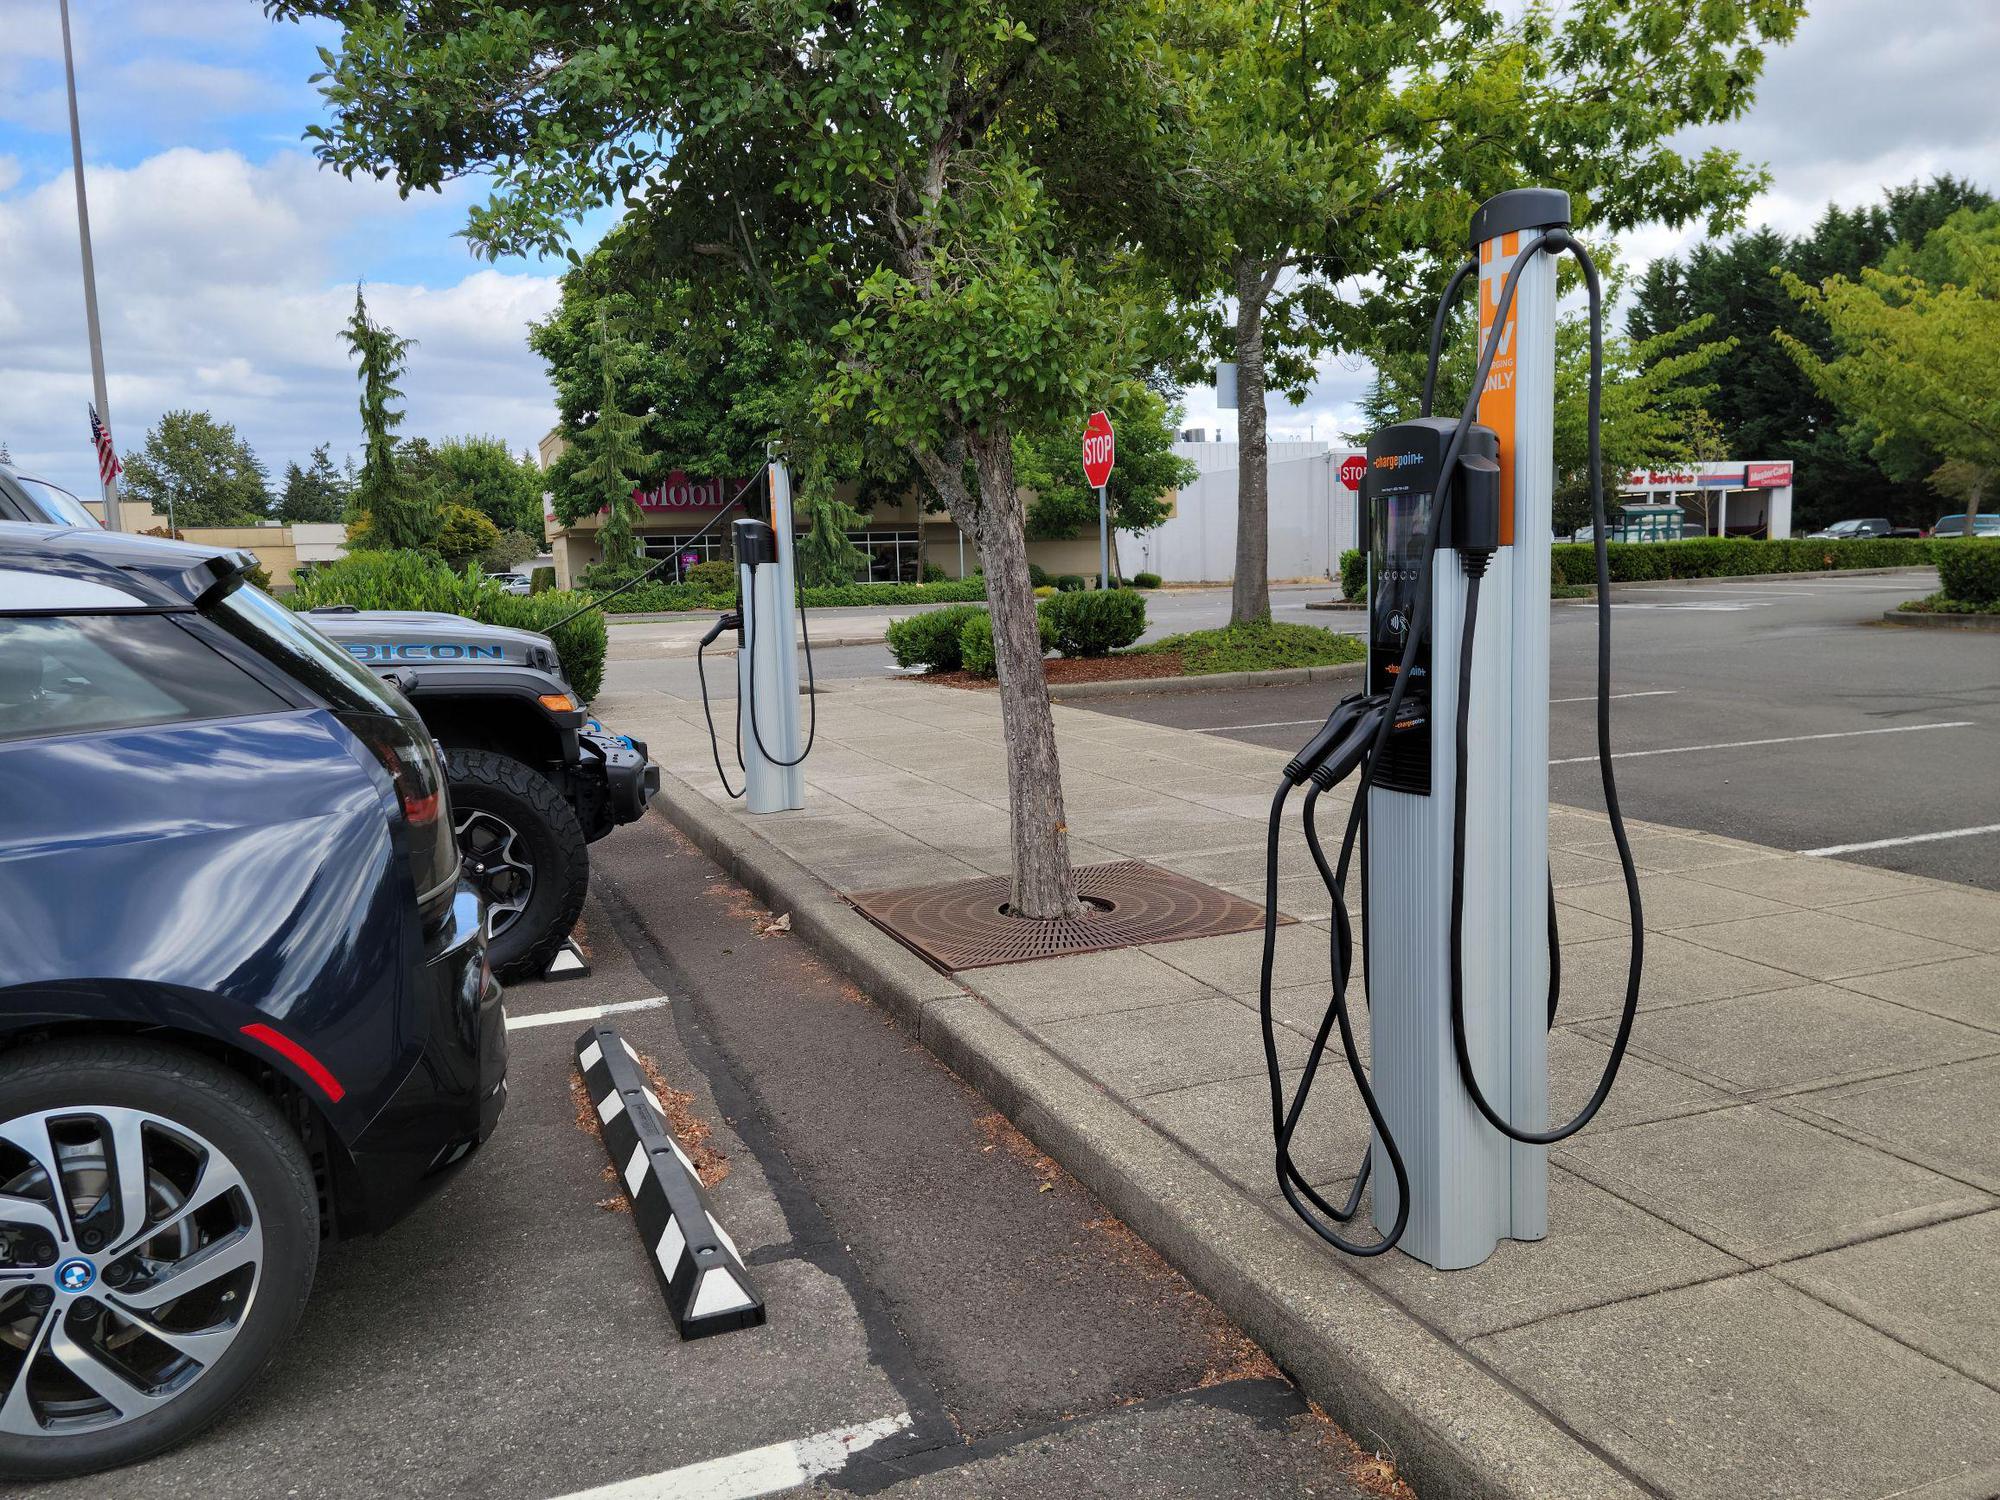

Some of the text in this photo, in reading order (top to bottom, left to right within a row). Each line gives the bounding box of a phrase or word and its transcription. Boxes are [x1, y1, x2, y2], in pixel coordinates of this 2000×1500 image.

[1491, 358, 1513, 369] RGING
[1085, 434, 1112, 465] STOP
[1649, 471, 1694, 485] Service
[341, 643, 504, 661] BICON
